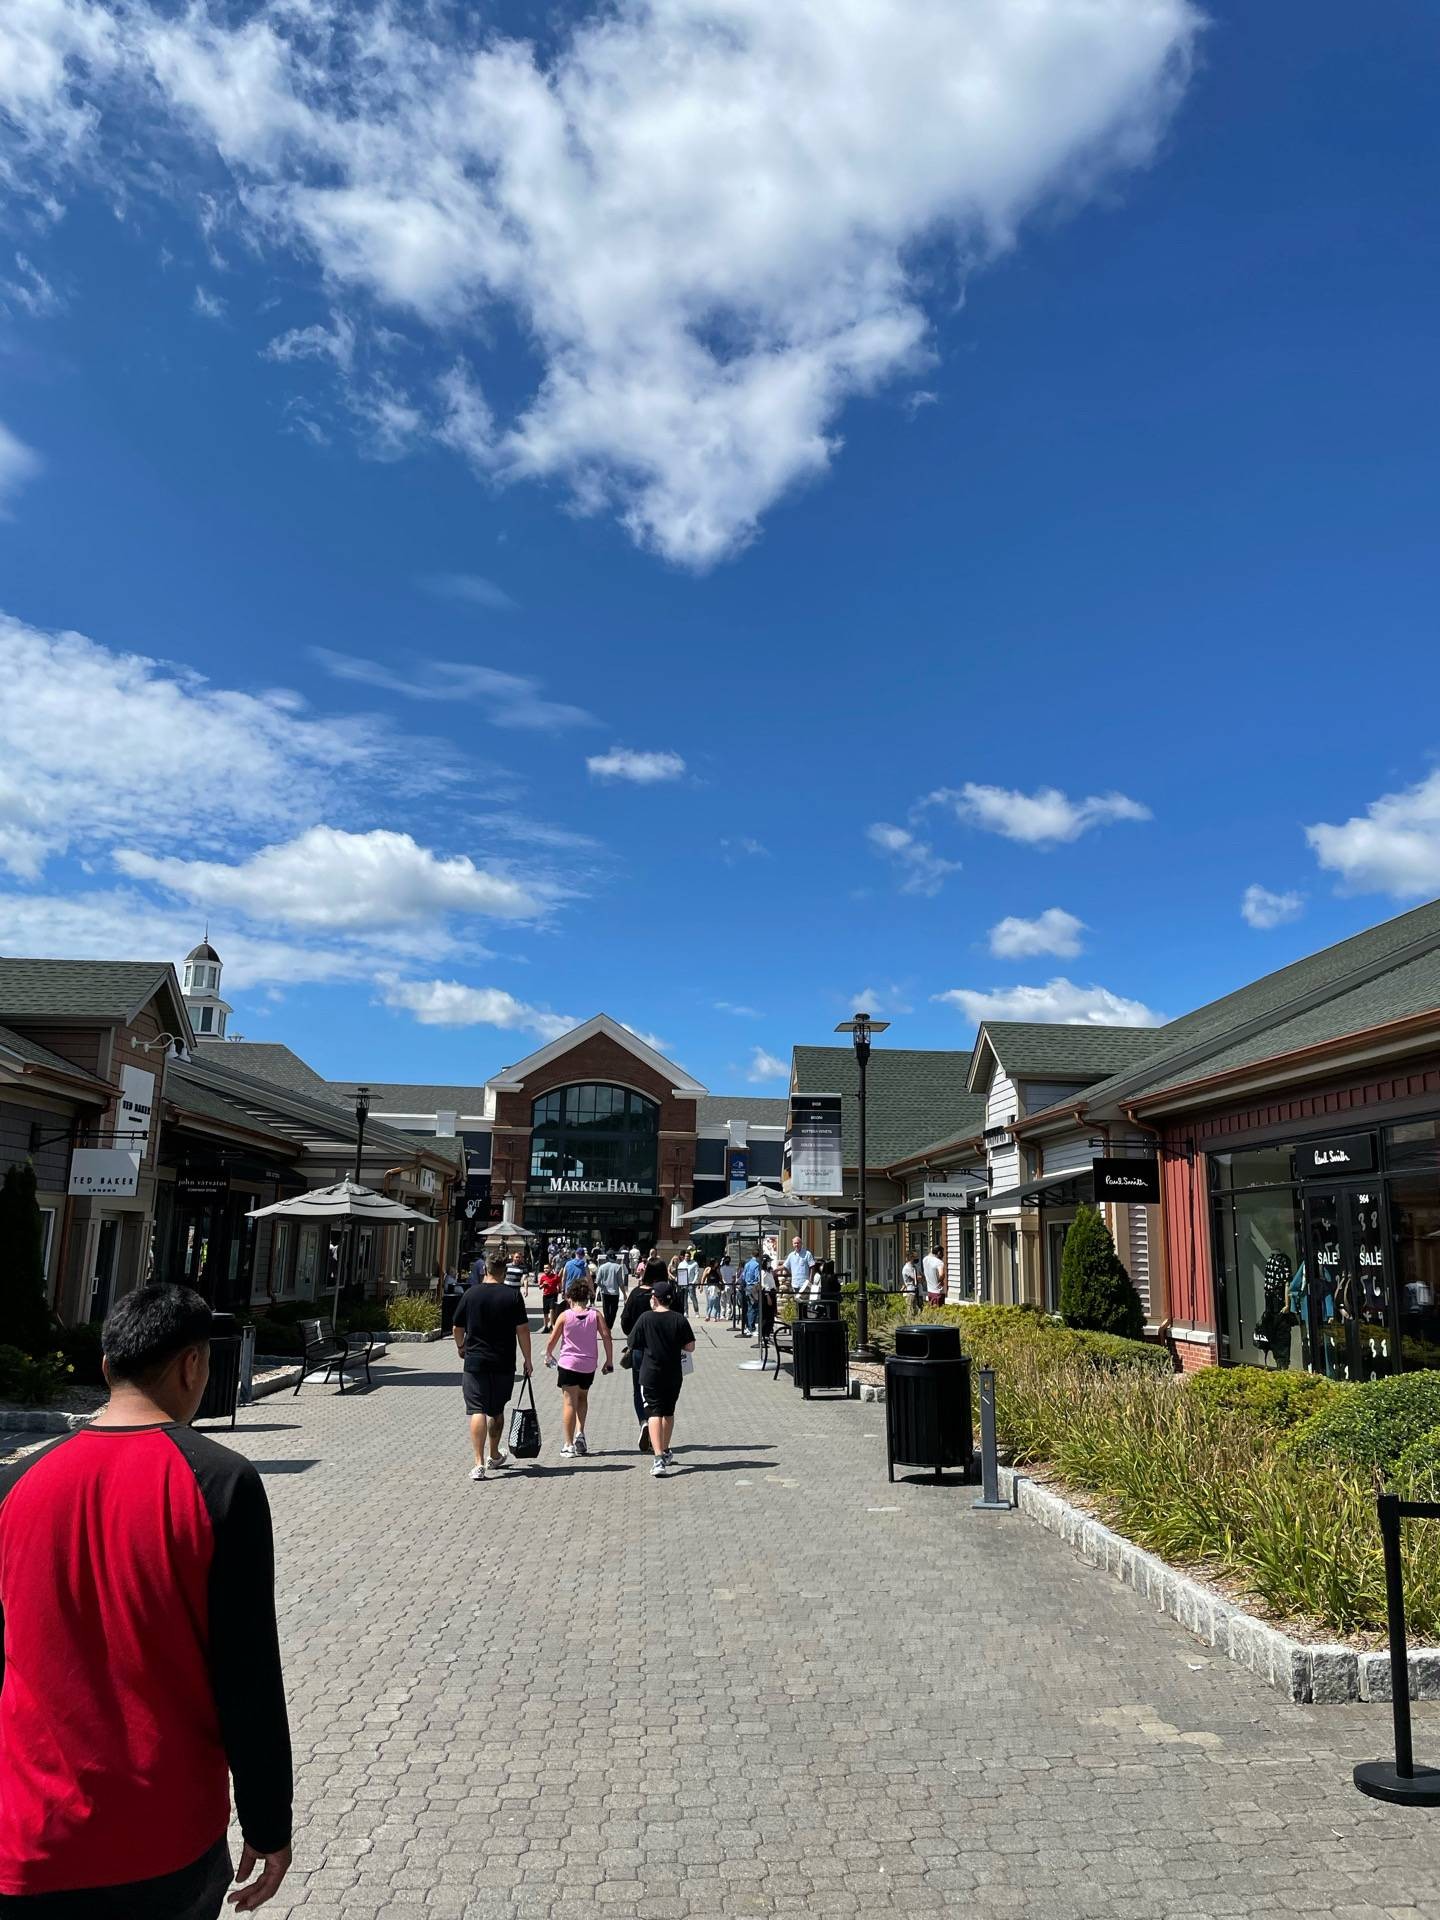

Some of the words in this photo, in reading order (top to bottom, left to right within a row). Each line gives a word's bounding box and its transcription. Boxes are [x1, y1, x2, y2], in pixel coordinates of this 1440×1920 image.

[123, 1100, 133, 1110] TED
[1328, 1149, 1351, 1163] Smith
[73, 1176, 93, 1185] TED
[100, 1177, 134, 1185] BAKER
[1105, 1175, 1123, 1185] Paul
[1122, 1176, 1149, 1187] Smith
[1317, 1251, 1339, 1265] SALE
[1359, 1251, 1383, 1267] SALE
